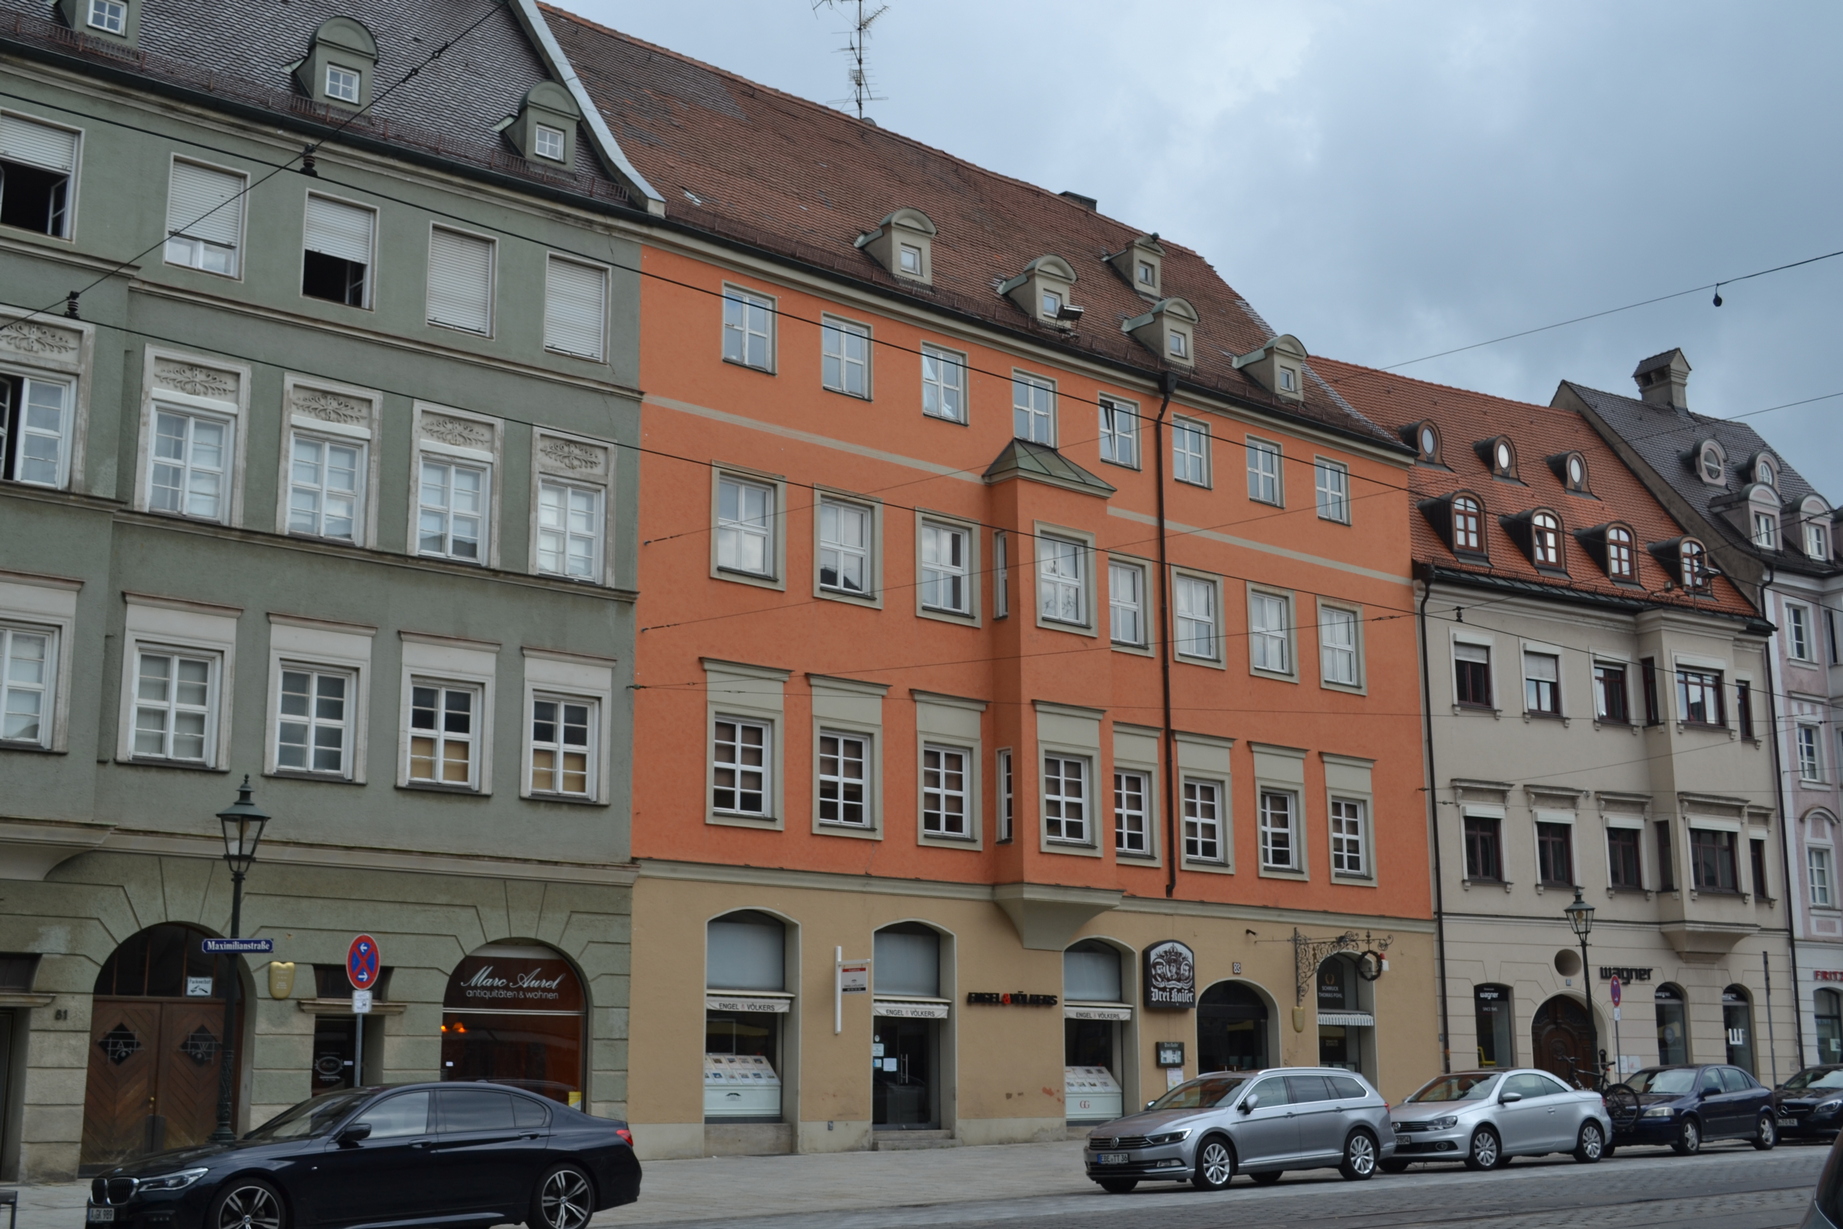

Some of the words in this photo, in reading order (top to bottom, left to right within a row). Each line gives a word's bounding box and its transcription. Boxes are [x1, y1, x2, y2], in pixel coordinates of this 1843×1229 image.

[207, 941, 270, 951] Maximilianstraße
[460, 965, 507, 987] Marc
[509, 967, 566, 990] Aurel
[1600, 967, 1653, 985] wagner
[466, 988, 518, 999] antiquitäten
[519, 991, 525, 999] &
[525, 990, 559, 999] wohnen
[1003, 993, 1011, 1004] &
[1151, 987, 1170, 1002] Drei
[1480, 992, 1499, 1000] wagner
[747, 1003, 775, 1011] VÖLKERS
[910, 1009, 935, 1017] VÖLKERS
